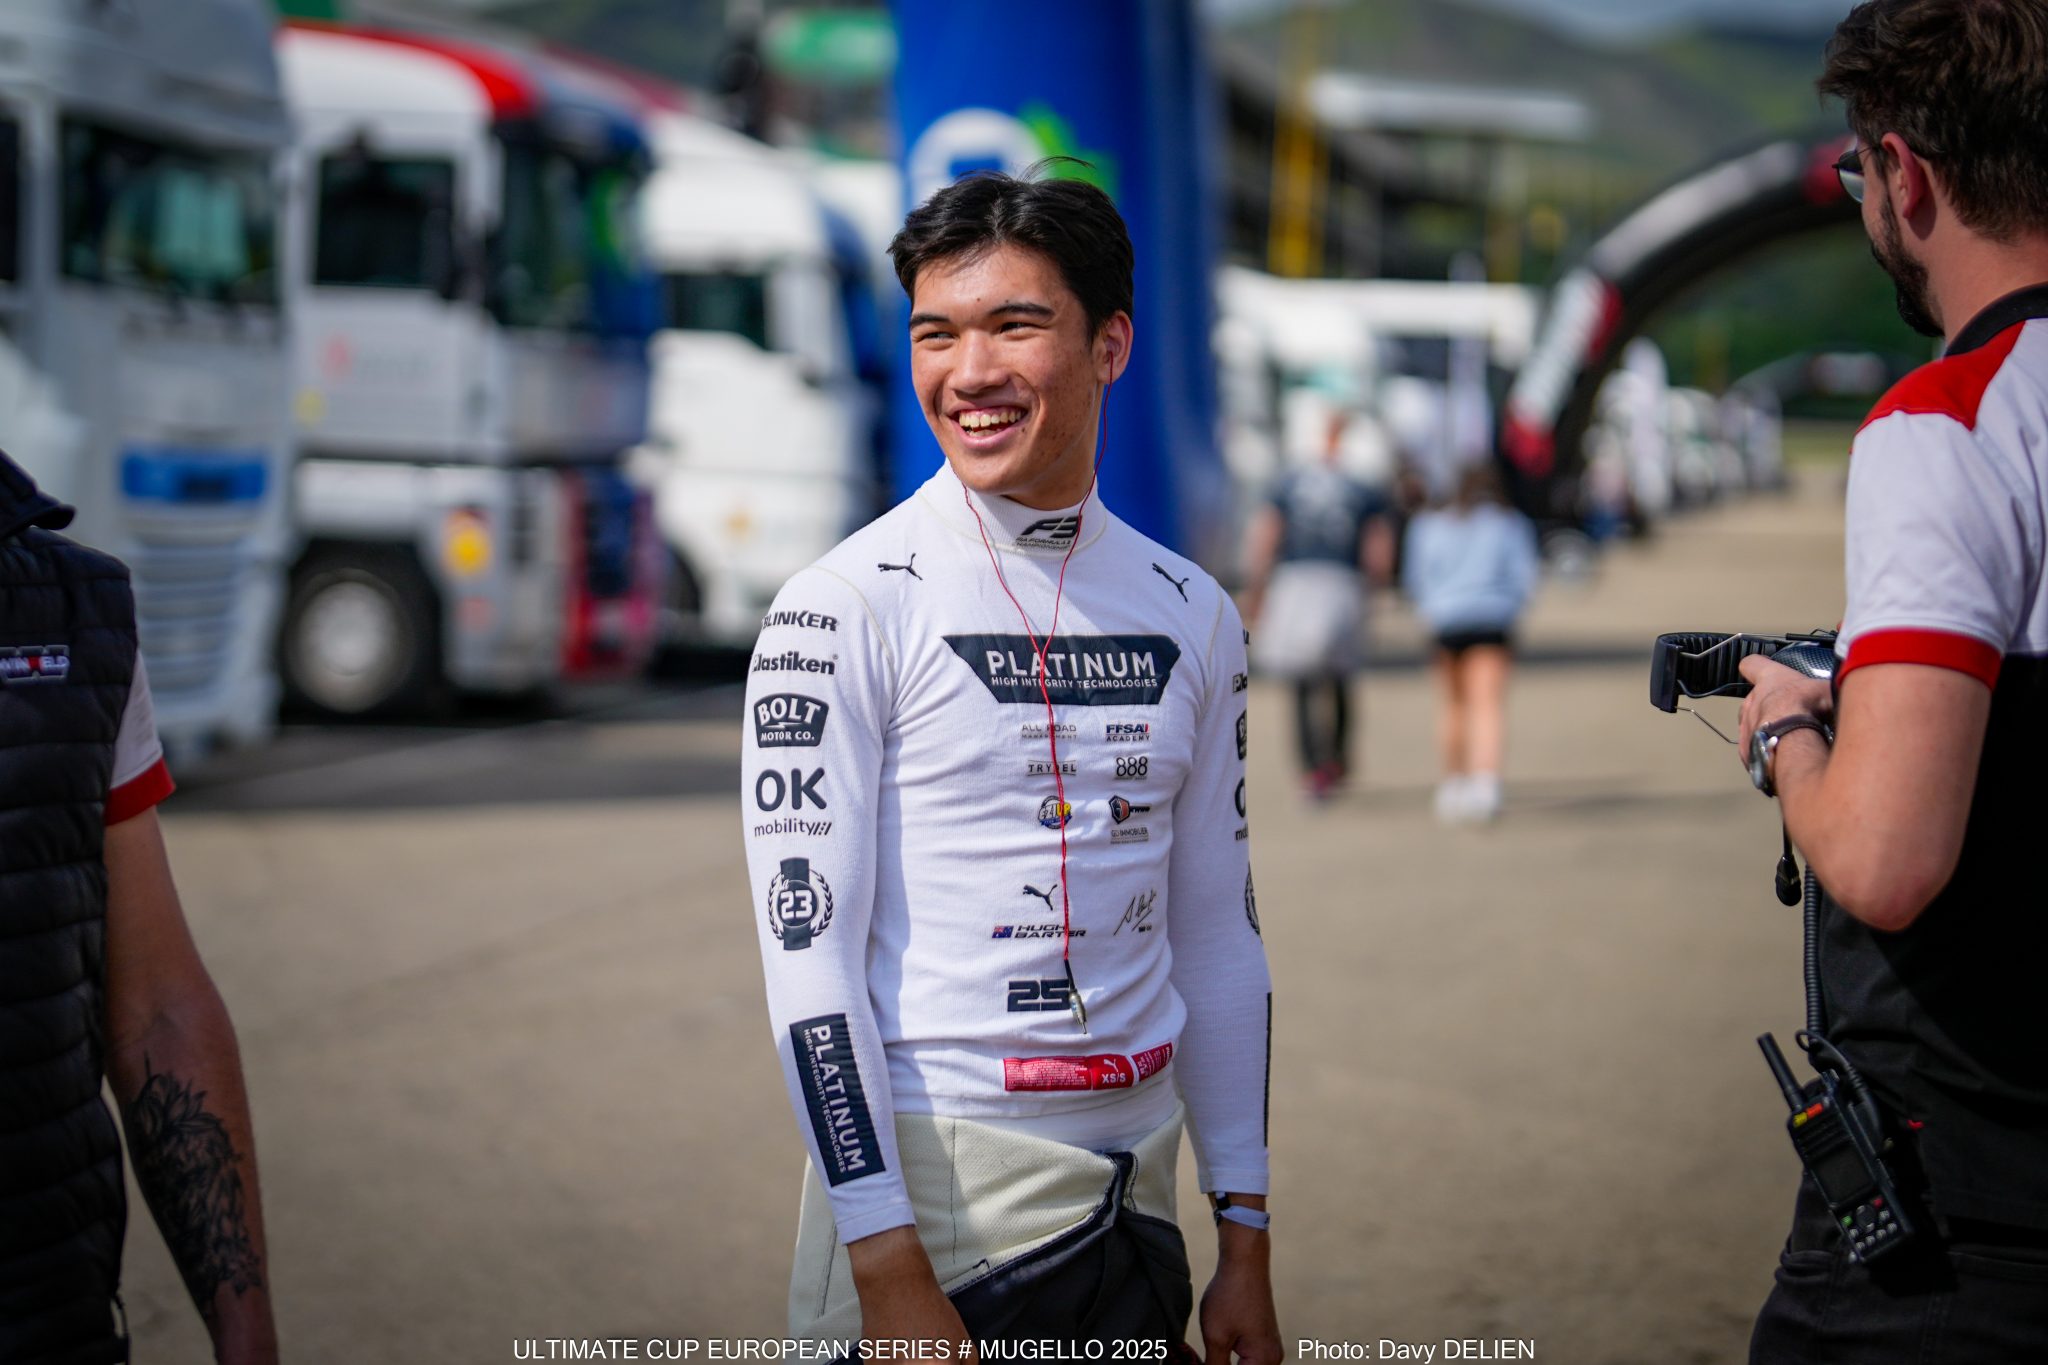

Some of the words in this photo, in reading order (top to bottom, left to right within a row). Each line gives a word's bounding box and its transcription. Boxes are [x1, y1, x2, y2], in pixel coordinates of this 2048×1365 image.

[986, 650, 1156, 679] PLATINUM
[992, 676, 1018, 687] HIGH
[1077, 678, 1158, 689] TECHNOLOGIES
[757, 698, 821, 726] BOLT
[760, 730, 792, 742] MOTOR
[795, 731, 815, 741] CO.
[1116, 756, 1148, 777] 888
[756, 767, 827, 812] OK
[780, 889, 813, 920] 23
[1007, 978, 1071, 1013] 25
[803, 1028, 814, 1052] HIGH
[809, 1054, 827, 1101] INTEGRITY
[822, 1103, 847, 1173] TECHNOLOGIES
[811, 1023, 867, 1171] PLATINUM
